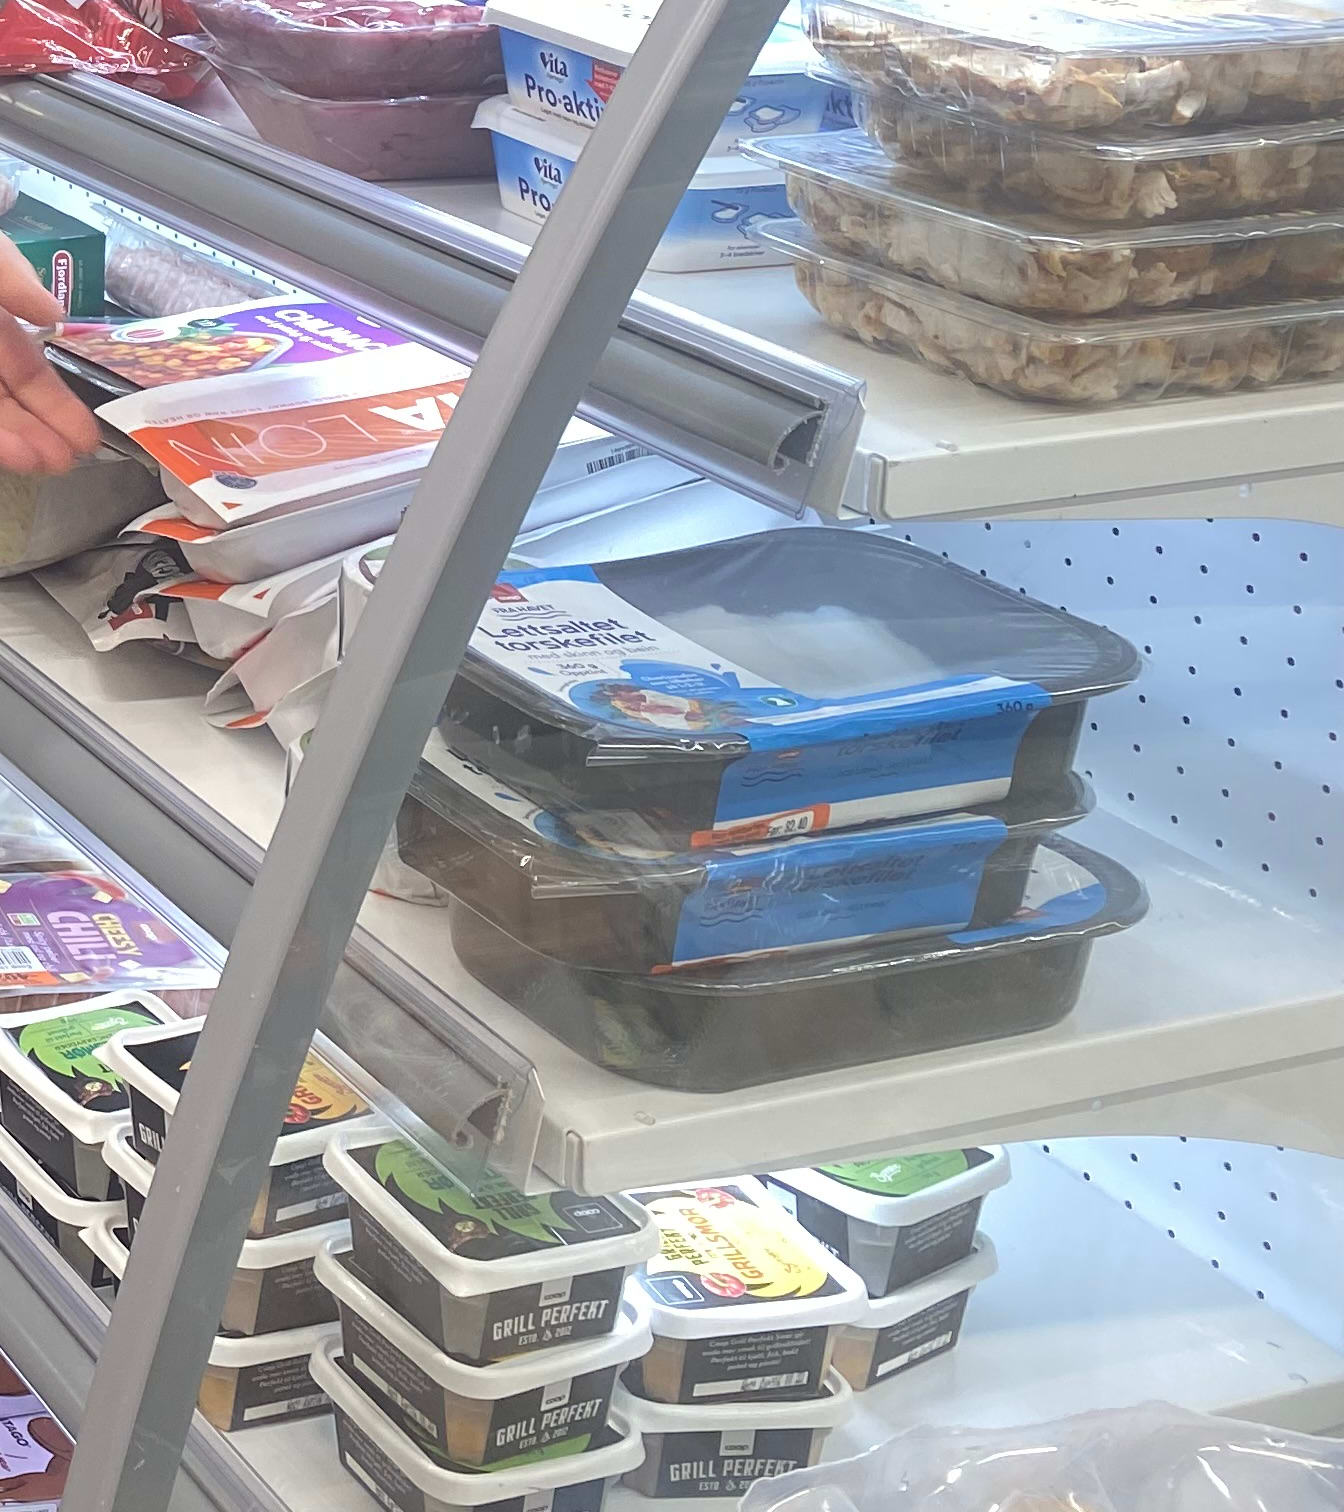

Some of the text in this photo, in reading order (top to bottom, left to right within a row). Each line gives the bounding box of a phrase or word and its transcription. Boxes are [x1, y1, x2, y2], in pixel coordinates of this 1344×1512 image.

[168, 414, 379, 468] LOIN
[478, 618, 629, 639] Lettsaltet
[495, 630, 657, 653] torskefillet
[46, 910, 117, 962] CHILI
[91, 913, 143, 958] CHEESY
[493, 1299, 610, 1341] GRILL PERFEKT
[496, 1398, 603, 1447] GRILL PERFEKT
[669, 1462, 716, 1483] GRILL
